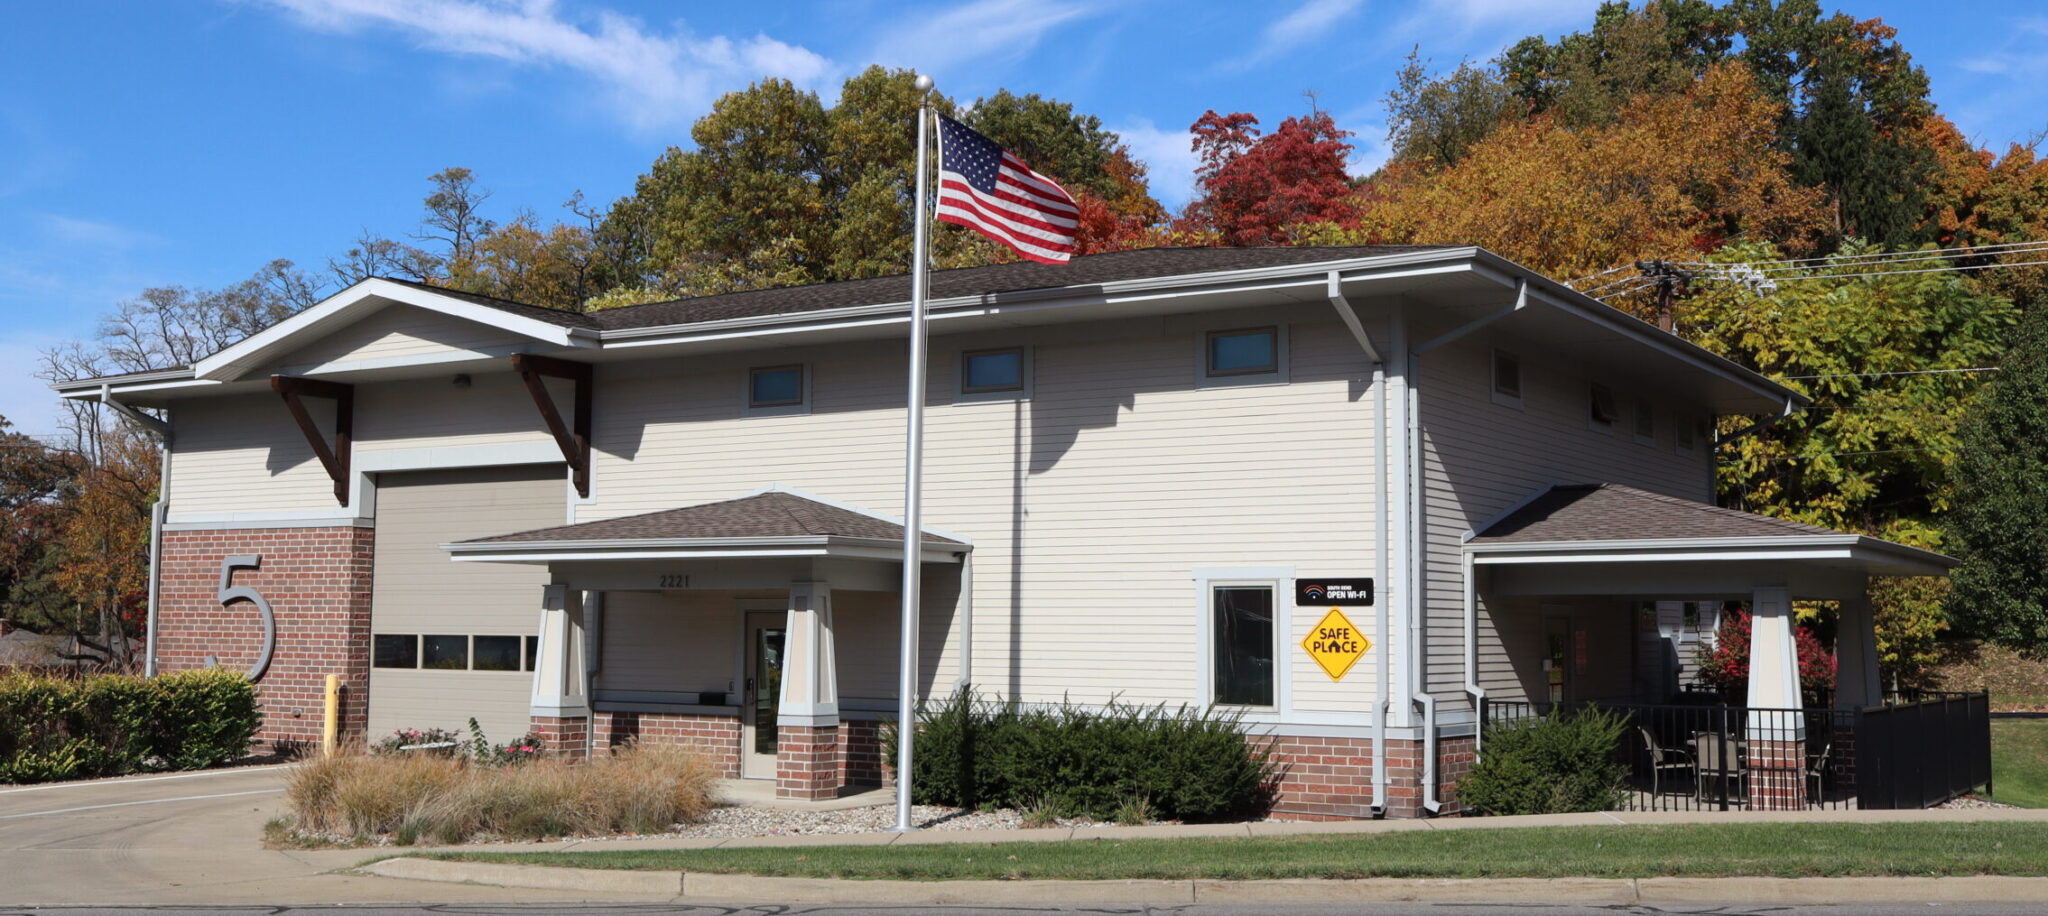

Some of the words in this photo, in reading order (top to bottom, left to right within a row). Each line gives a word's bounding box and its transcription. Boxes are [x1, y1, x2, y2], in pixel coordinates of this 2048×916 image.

[660, 575, 689, 588] 2221
[1327, 591, 1346, 599] OPEN
[1347, 591, 1366, 599] WI-FI
[205, 554, 276, 683] 5
[1320, 628, 1350, 640] SAFE
